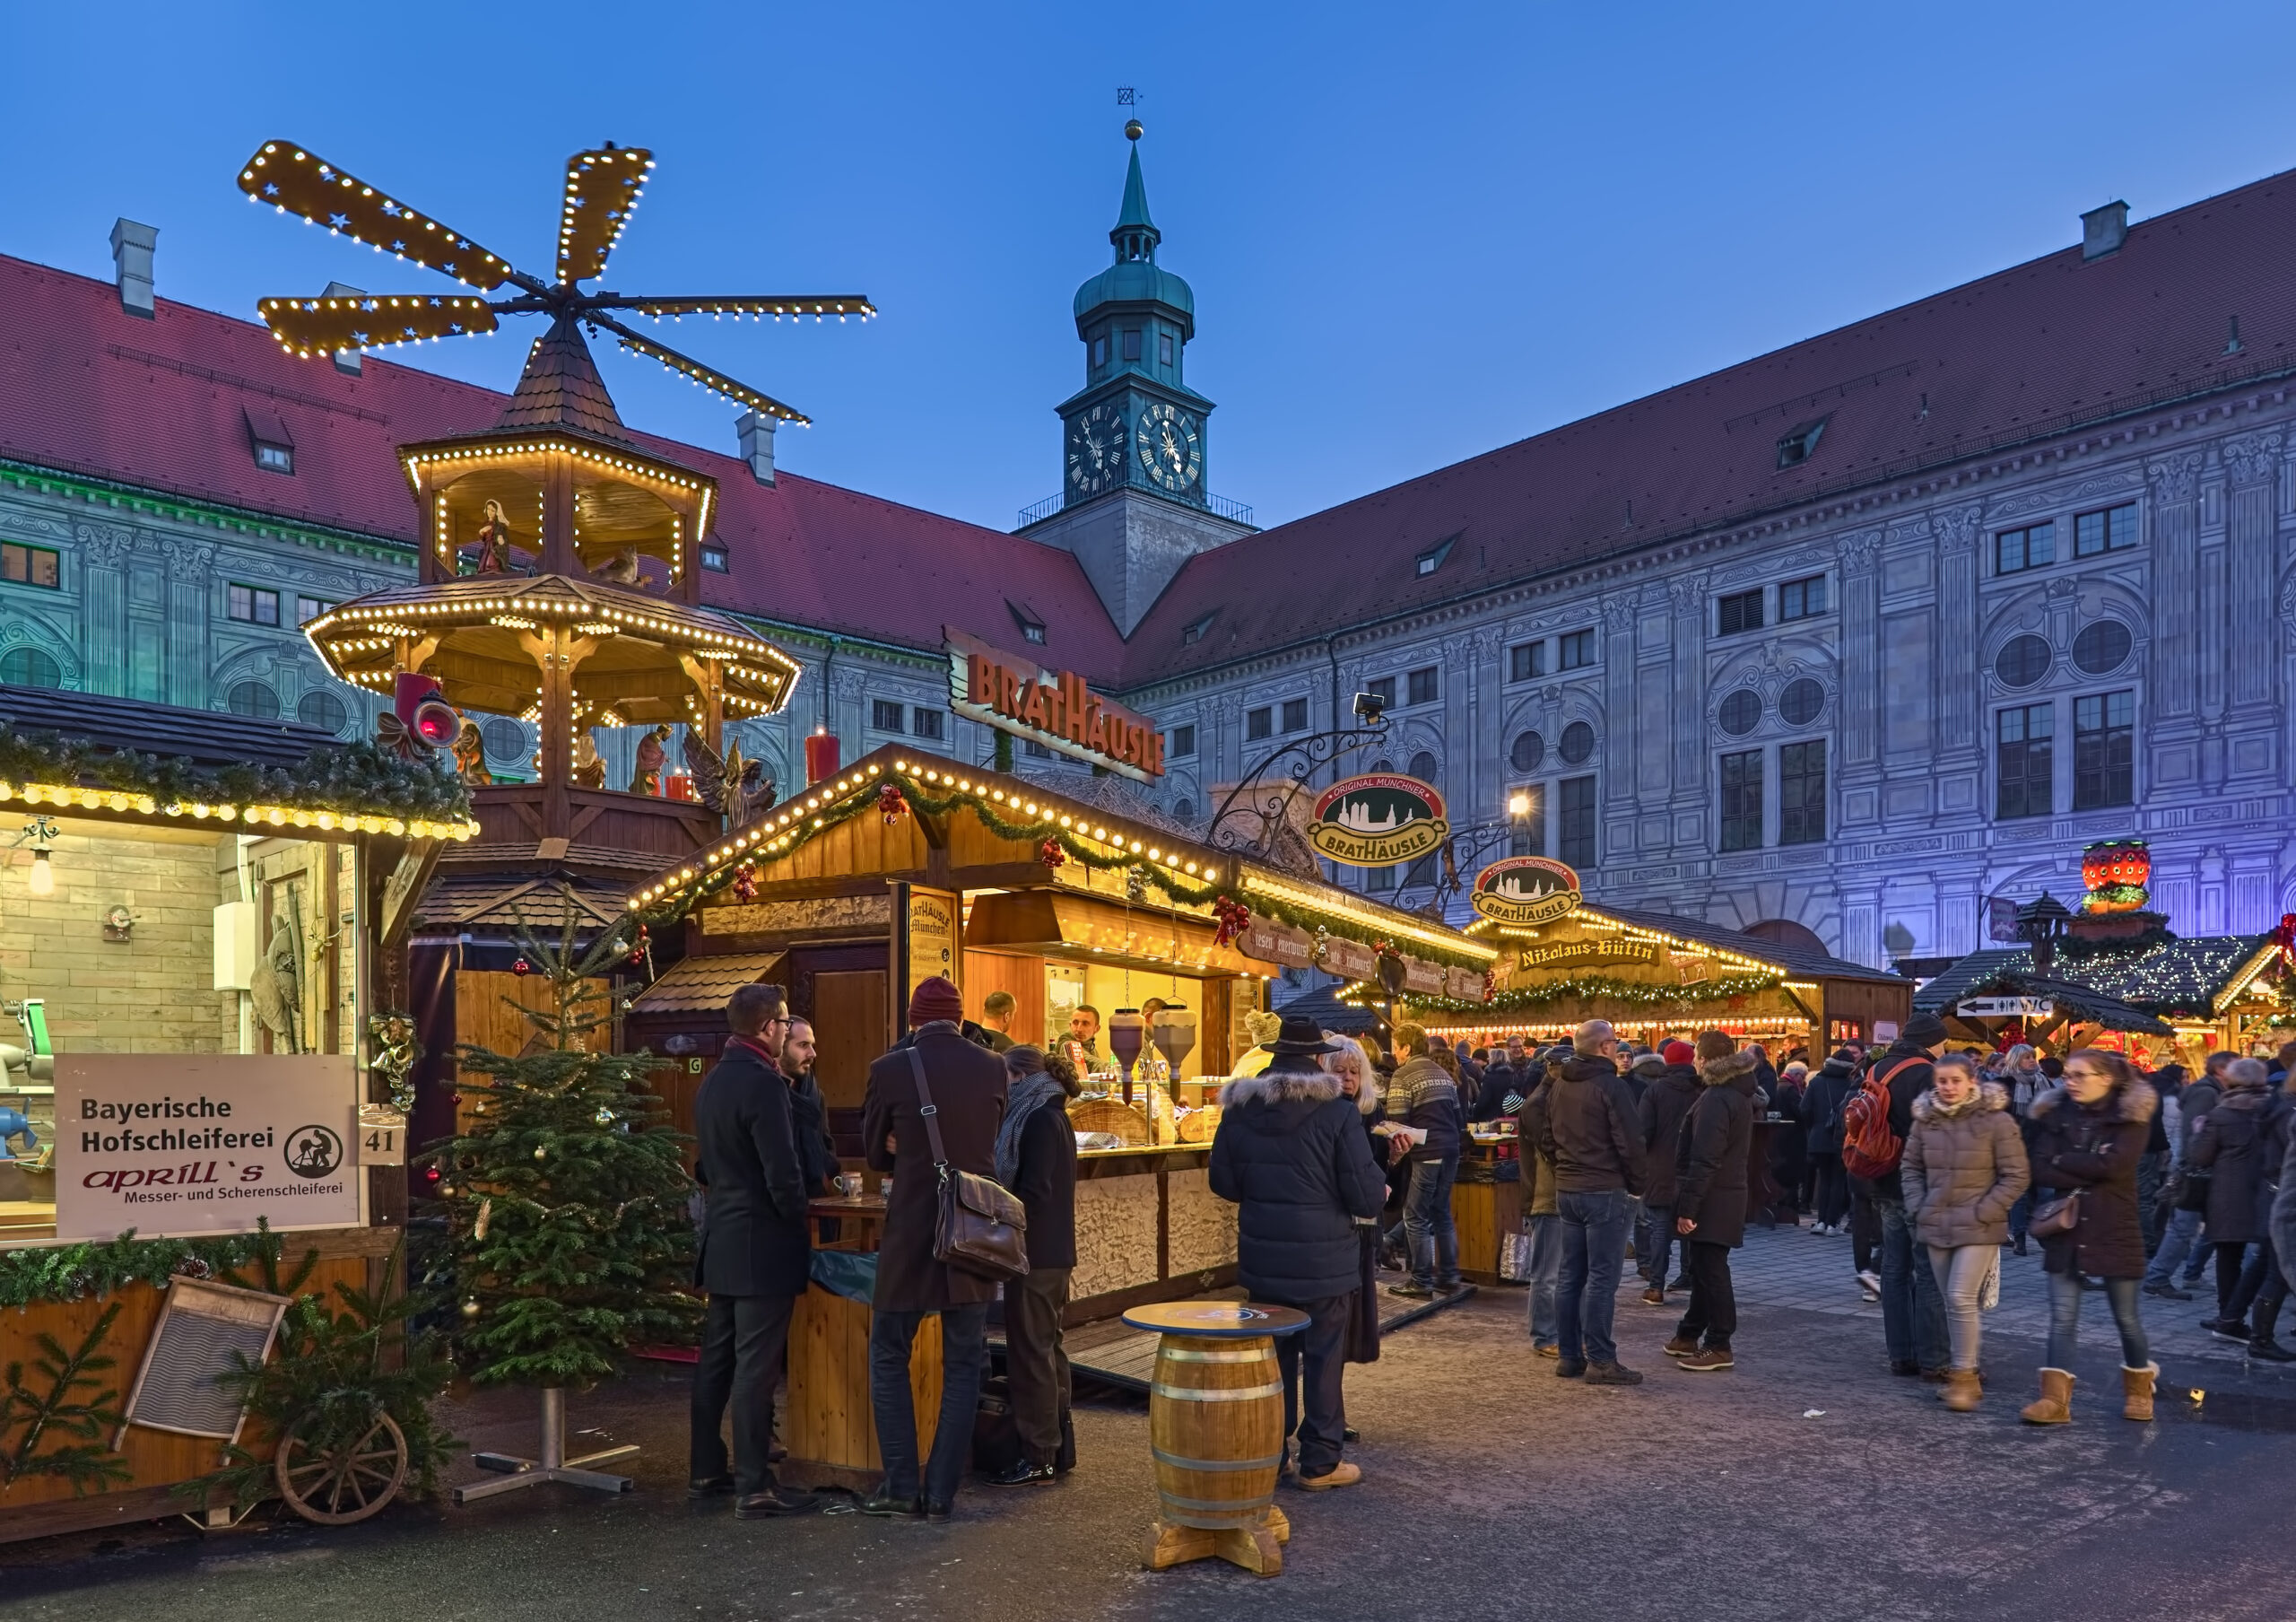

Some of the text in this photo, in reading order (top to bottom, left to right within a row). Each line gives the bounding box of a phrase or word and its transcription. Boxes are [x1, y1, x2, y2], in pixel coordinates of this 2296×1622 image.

[967, 653, 1165, 777] BRATHÄUSLE
[1334, 777, 1426, 798] ORIGINAL MÜNCHNER
[1325, 832, 1429, 860] BRATHÄUSLE
[1492, 859, 1564, 875] ORIGINAL MÜNCHNER
[1485, 900, 1566, 922] BRATHÄUSLE
[910, 919, 945, 937] München
[2020, 998, 2050, 1012] WC
[691, 1059, 700, 1071] G
[81, 1096, 231, 1124] Bayerische
[81, 1127, 274, 1153] Hofschleiferei
[365, 1129, 395, 1152] 41
[125, 1182, 344, 1204] Messer- und Scherenschleiferei
